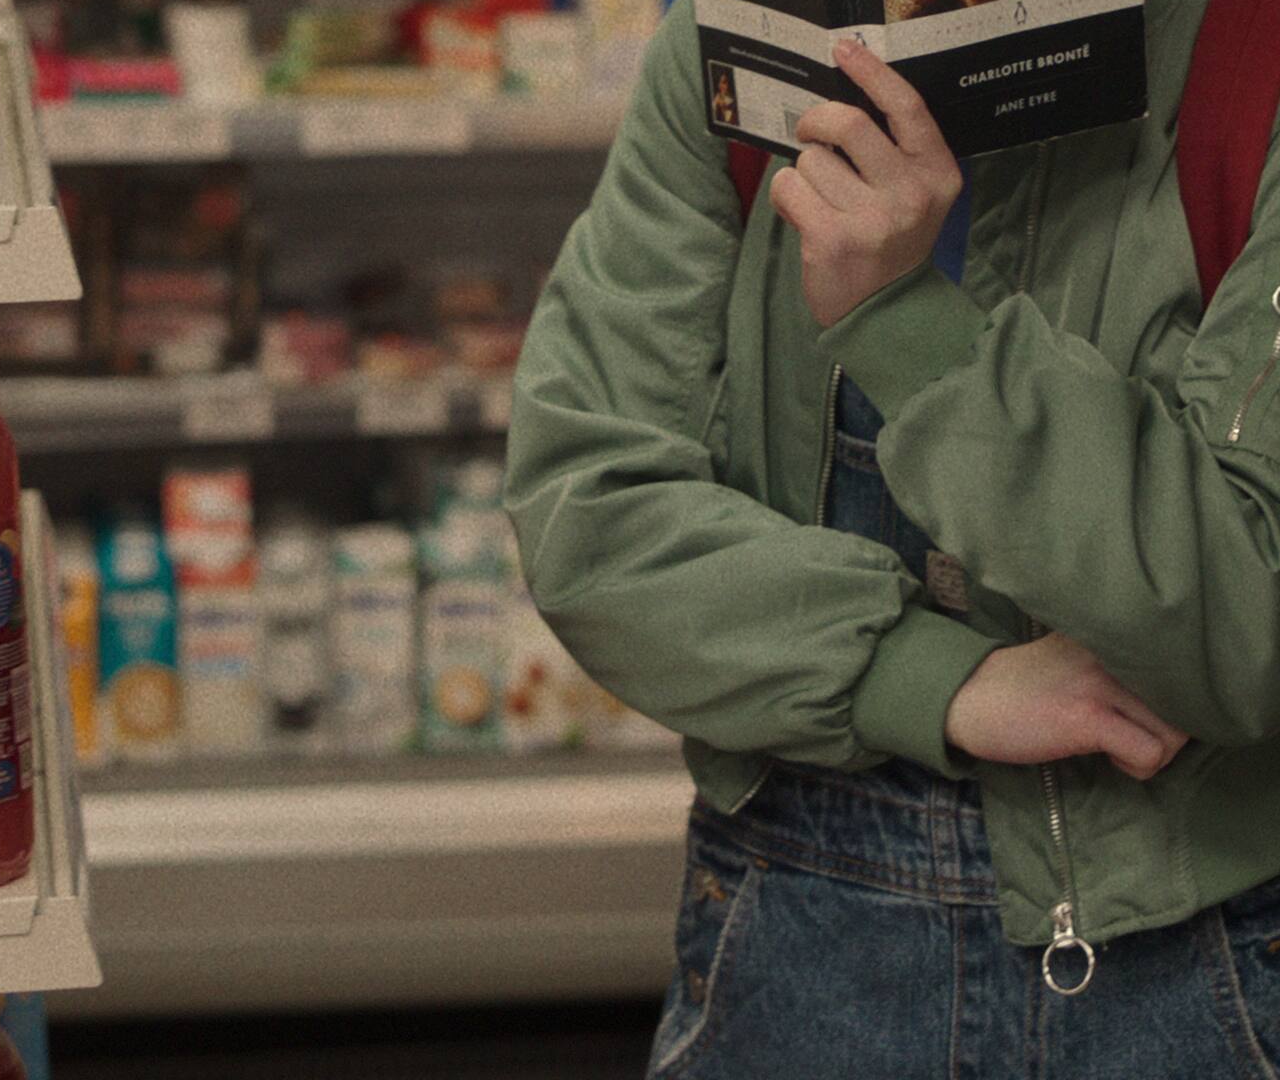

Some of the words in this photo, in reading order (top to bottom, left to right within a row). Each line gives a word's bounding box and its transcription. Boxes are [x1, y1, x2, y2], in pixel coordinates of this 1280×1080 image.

[959, 59, 1033, 87] CHARLOTTE
[994, 98, 1025, 117] JANE
[1028, 90, 1057, 107] EYRE
